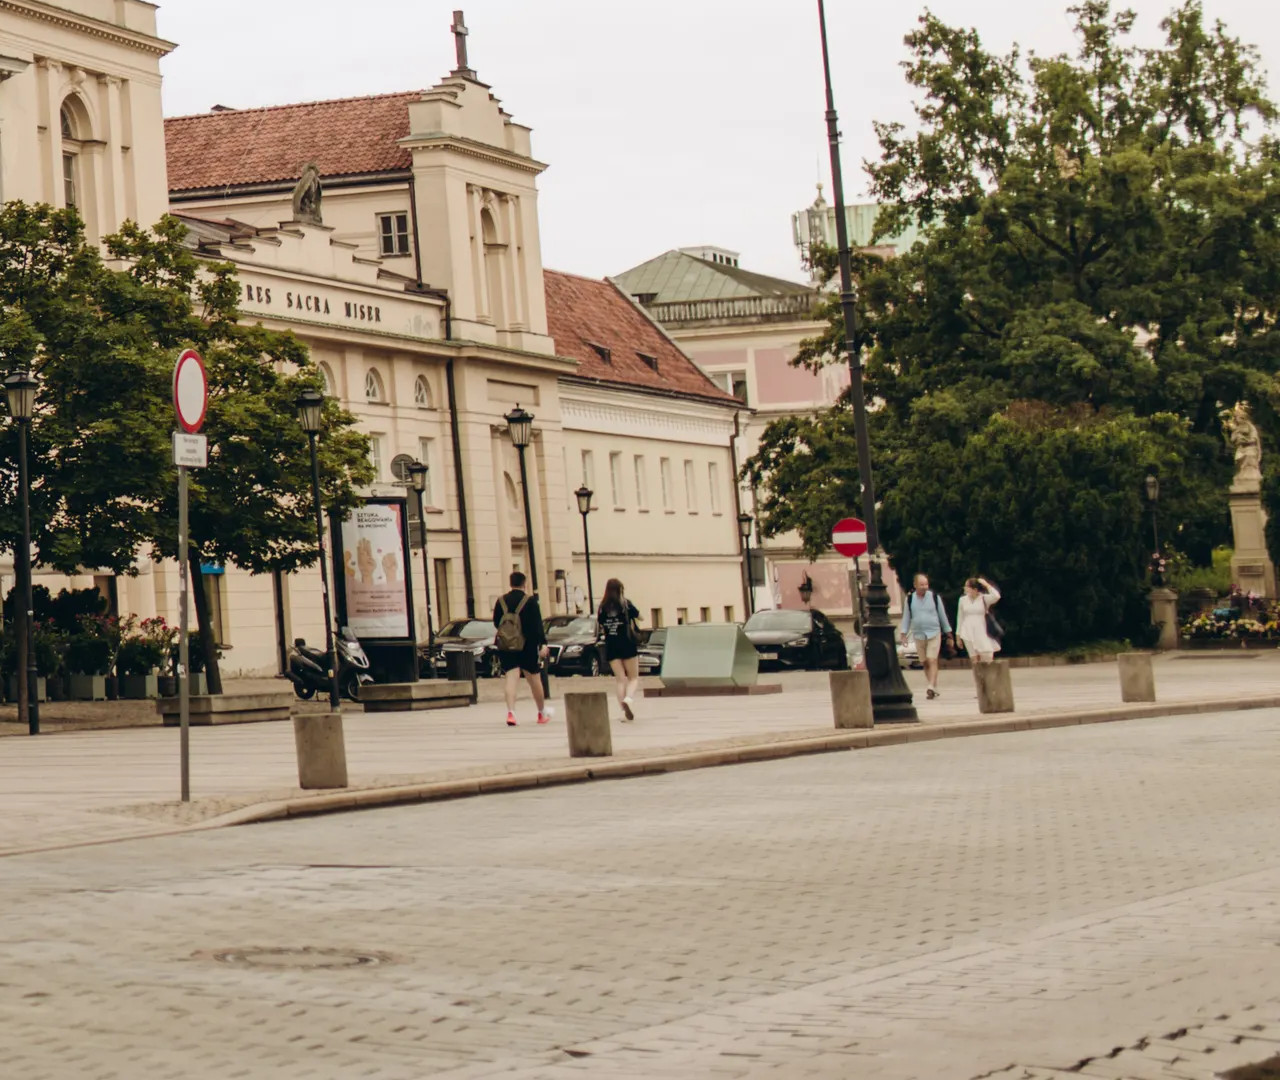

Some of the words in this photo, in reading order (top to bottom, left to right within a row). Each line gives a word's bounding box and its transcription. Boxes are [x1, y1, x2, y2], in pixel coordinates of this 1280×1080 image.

[246, 284, 272, 305] RES
[286, 292, 331, 315] SACRA
[344, 301, 382, 323] MISER
